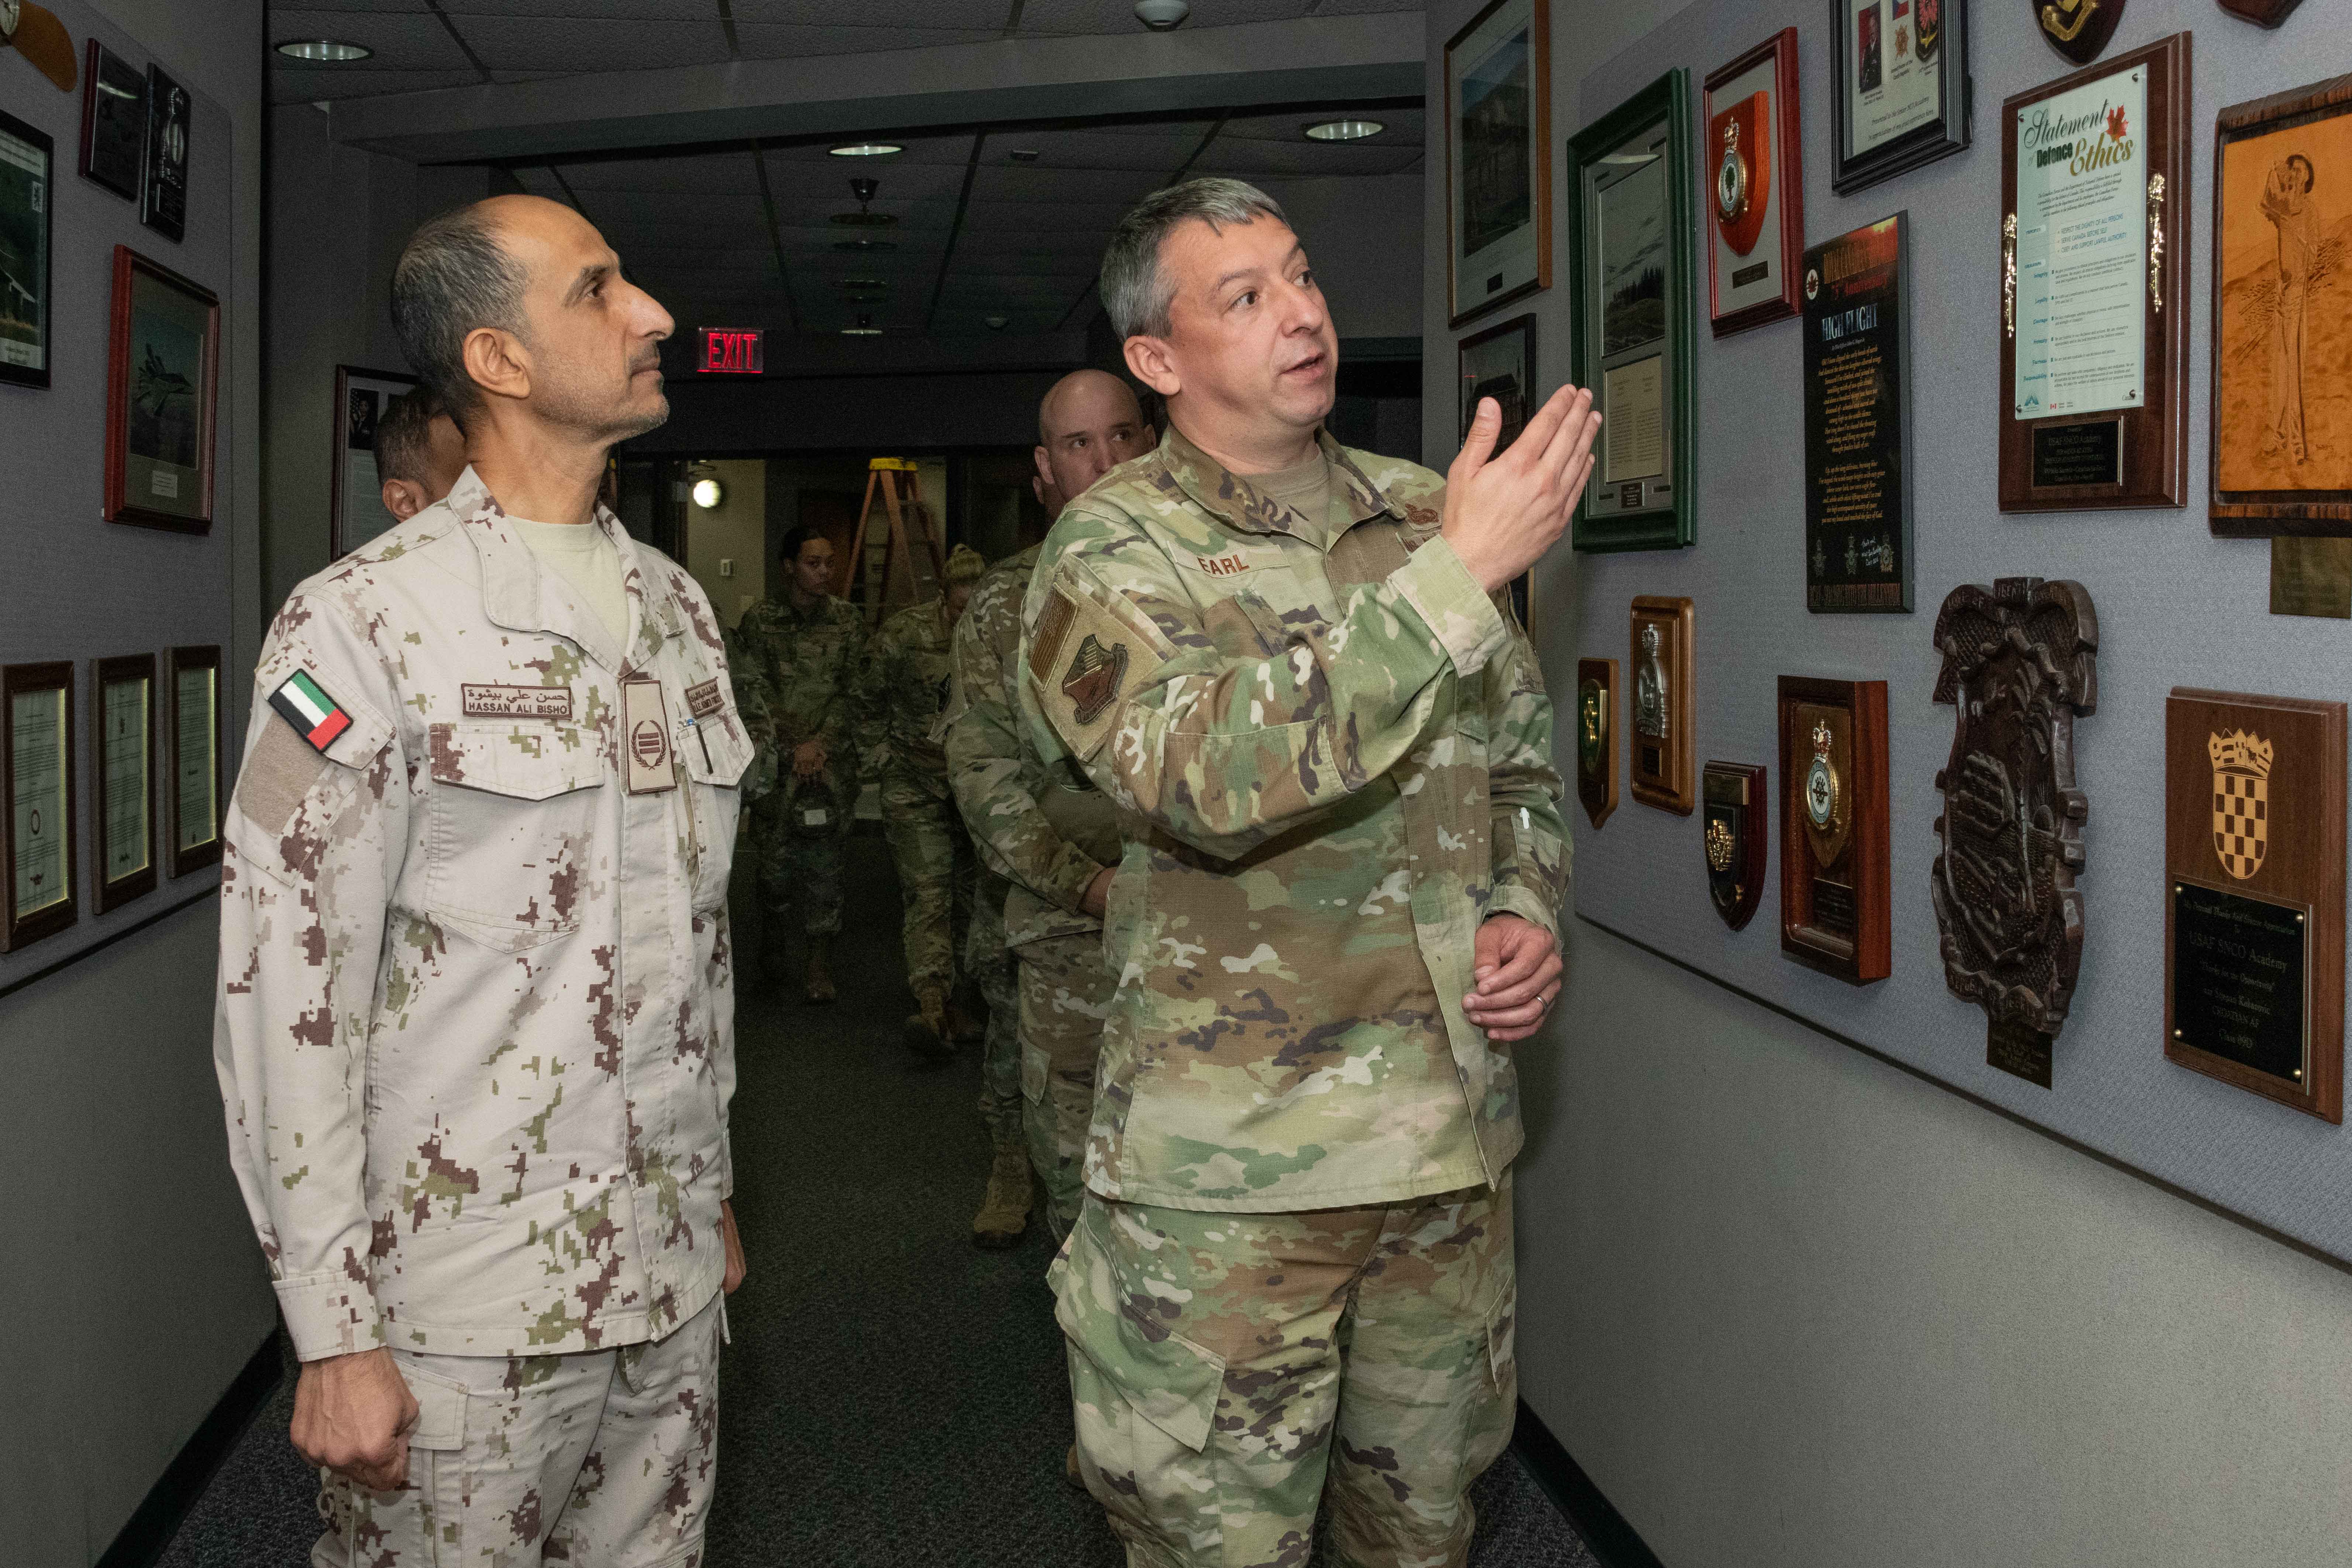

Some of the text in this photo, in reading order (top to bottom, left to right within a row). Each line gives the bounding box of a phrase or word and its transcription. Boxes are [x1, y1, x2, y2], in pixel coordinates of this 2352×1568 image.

[2024, 99, 2108, 148] Statement
[2036, 142, 2073, 168] Defence
[2070, 131, 2133, 176] Ethics
[1846, 303, 1878, 333] FLIGHT
[708, 333, 757, 369] EXIT
[1197, 554, 1250, 575] EARL
[469, 702, 567, 714] HASSAN ALI BISHO
[506, 689, 530, 703] علي
[536, 693, 567, 703] حسن
[2189, 931, 2287, 973] USAF SNCO Academy
